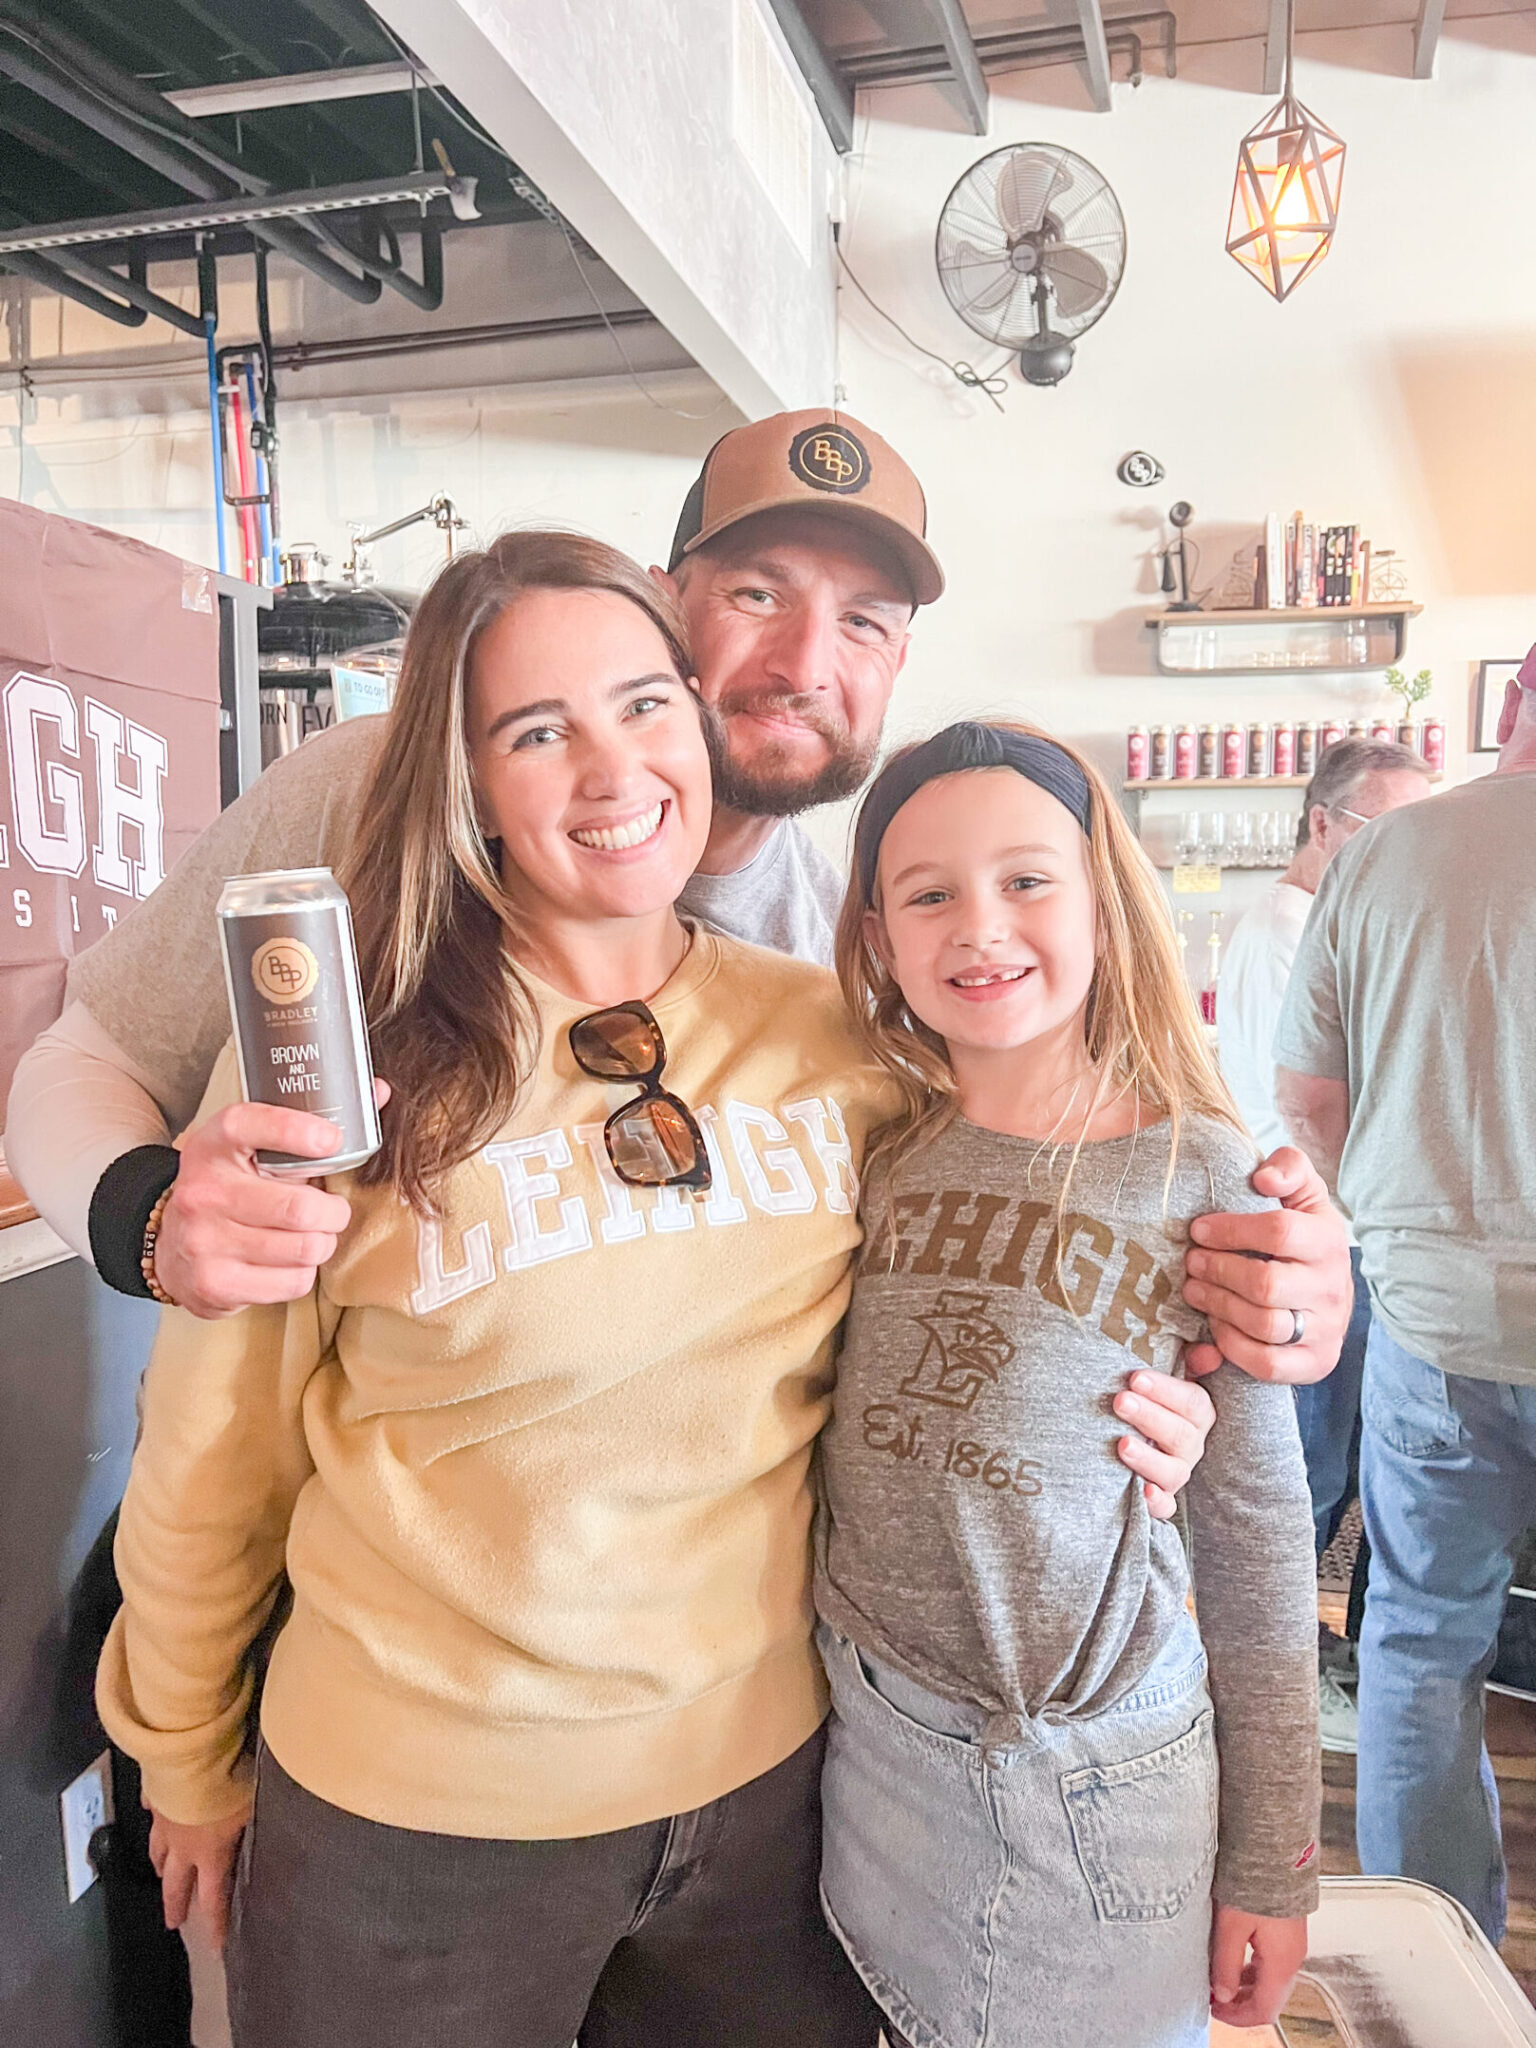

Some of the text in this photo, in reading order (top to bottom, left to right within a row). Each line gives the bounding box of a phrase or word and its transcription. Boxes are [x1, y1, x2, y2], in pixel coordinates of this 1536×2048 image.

[815, 439, 853, 481] BBP
[0, 671, 168, 901] GH
[268, 956, 302, 989] BBP
[263, 1006, 318, 1022] BRADLEY
[271, 1043, 320, 1065] BROWN
[289, 1063, 305, 1075] AND
[277, 1073, 321, 1095] WHITE
[410, 1096, 859, 1316] LEHIGH
[943, 1438, 1044, 1496] 1865
